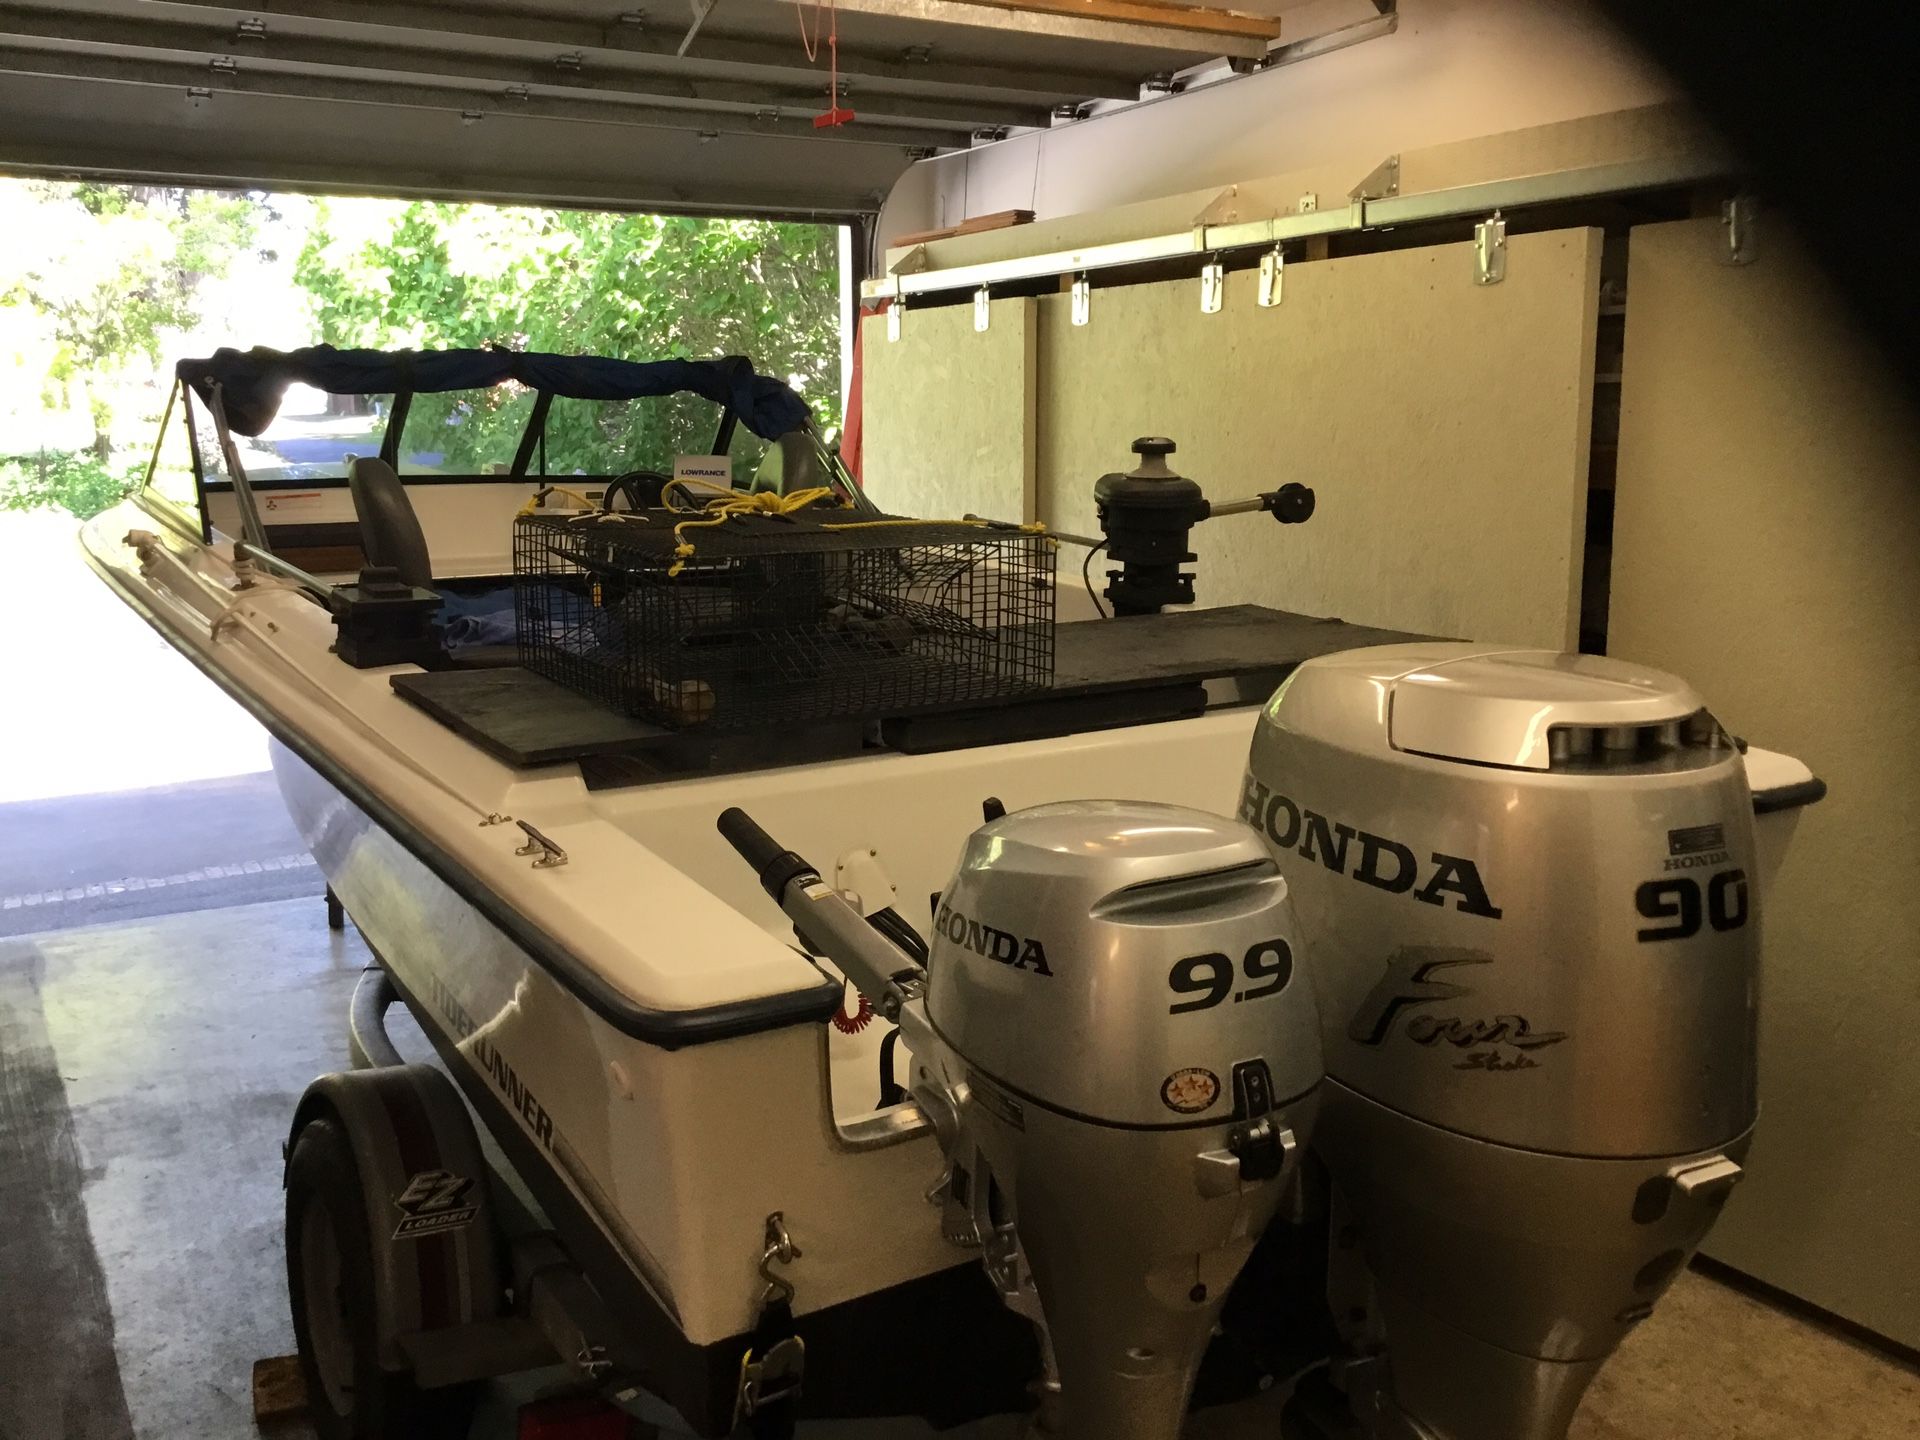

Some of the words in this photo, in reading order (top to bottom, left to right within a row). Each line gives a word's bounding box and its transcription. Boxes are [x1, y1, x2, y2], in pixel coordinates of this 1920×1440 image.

[681, 469, 726, 477] LOWRANCE
[1238, 773, 1503, 920] HONDA
[1664, 851, 1732, 871] HONDA
[1635, 869, 1748, 943] 90
[935, 902, 1053, 977] HONDA
[1169, 938, 1293, 1015] 9.9
[399, 1173, 468, 1212] EZ
[404, 1211, 471, 1231] LOADER
